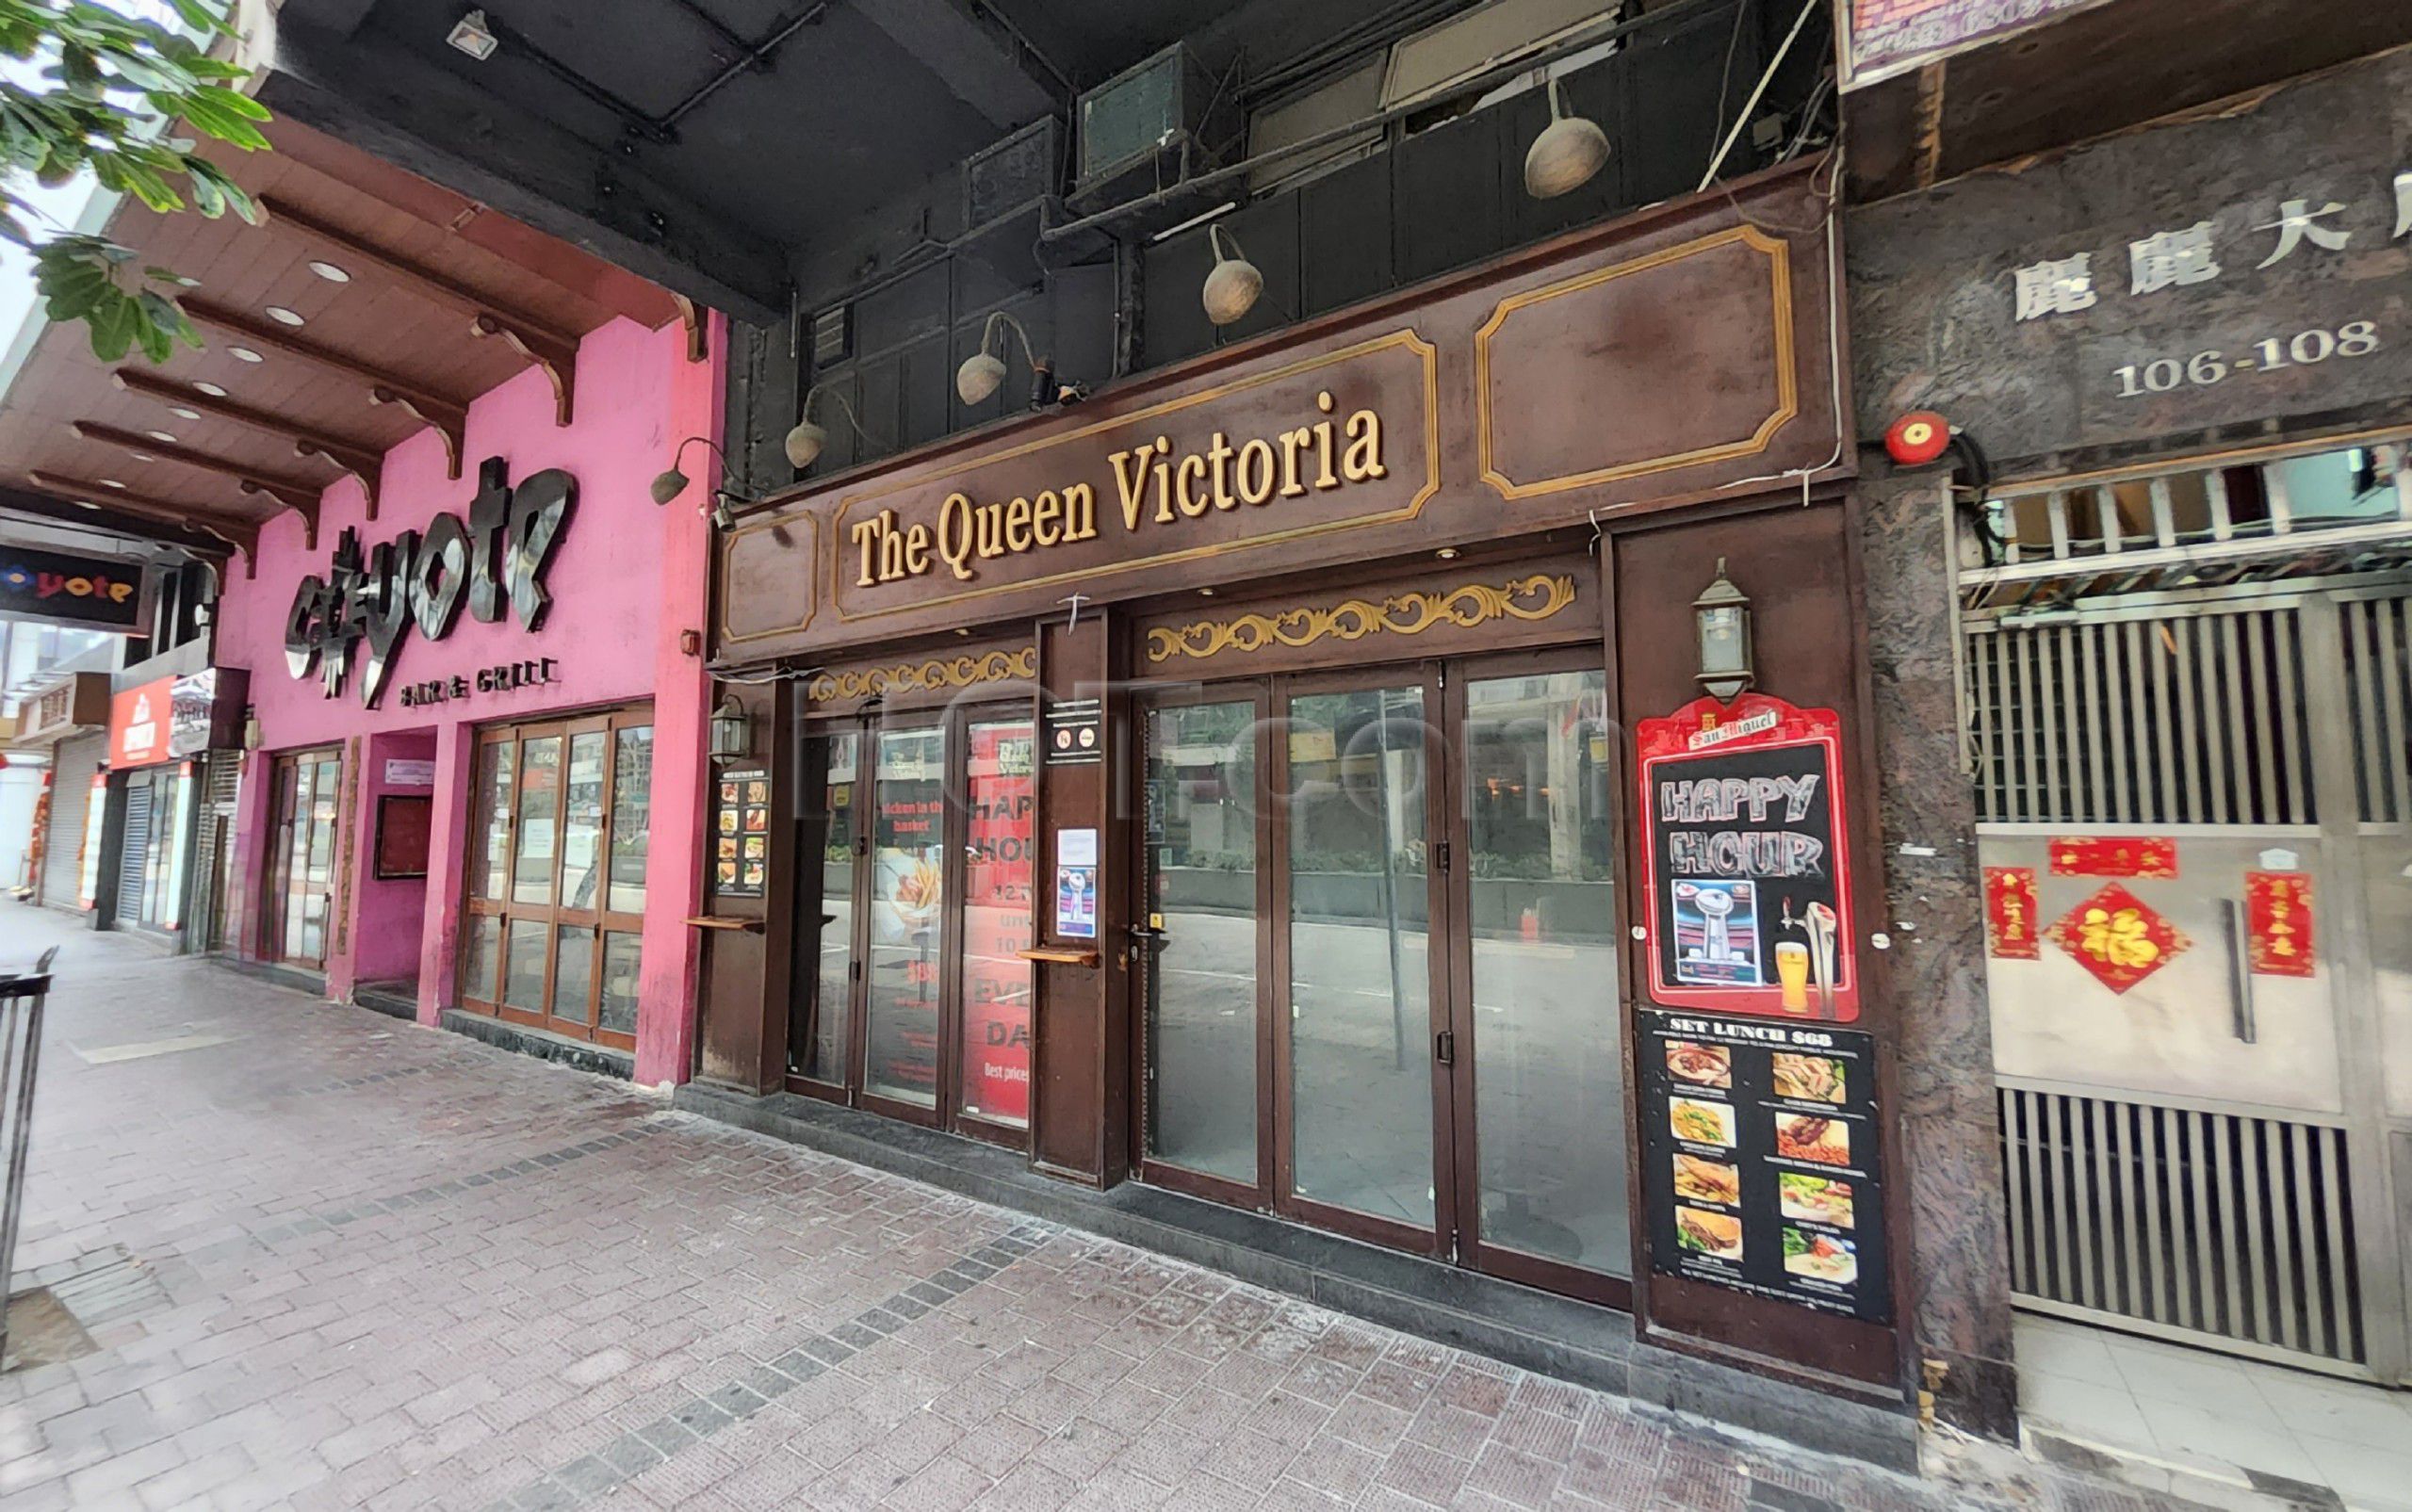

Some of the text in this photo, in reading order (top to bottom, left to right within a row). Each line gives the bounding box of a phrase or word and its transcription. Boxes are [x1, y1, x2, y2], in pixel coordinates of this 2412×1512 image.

[2014, 171, 2412, 322] 麗麗大
[2112, 320, 2378, 398] 106-108
[852, 391, 1386, 587] The Queen Victoria
[969, 795, 1034, 820] HAP
[1661, 774, 1820, 822] HAPPY
[1670, 831, 1825, 878] HOUR
[986, 1021, 1030, 1049] DA
[1670, 1017, 1709, 1032] SET
[1713, 1021, 1786, 1042] LUNCH
